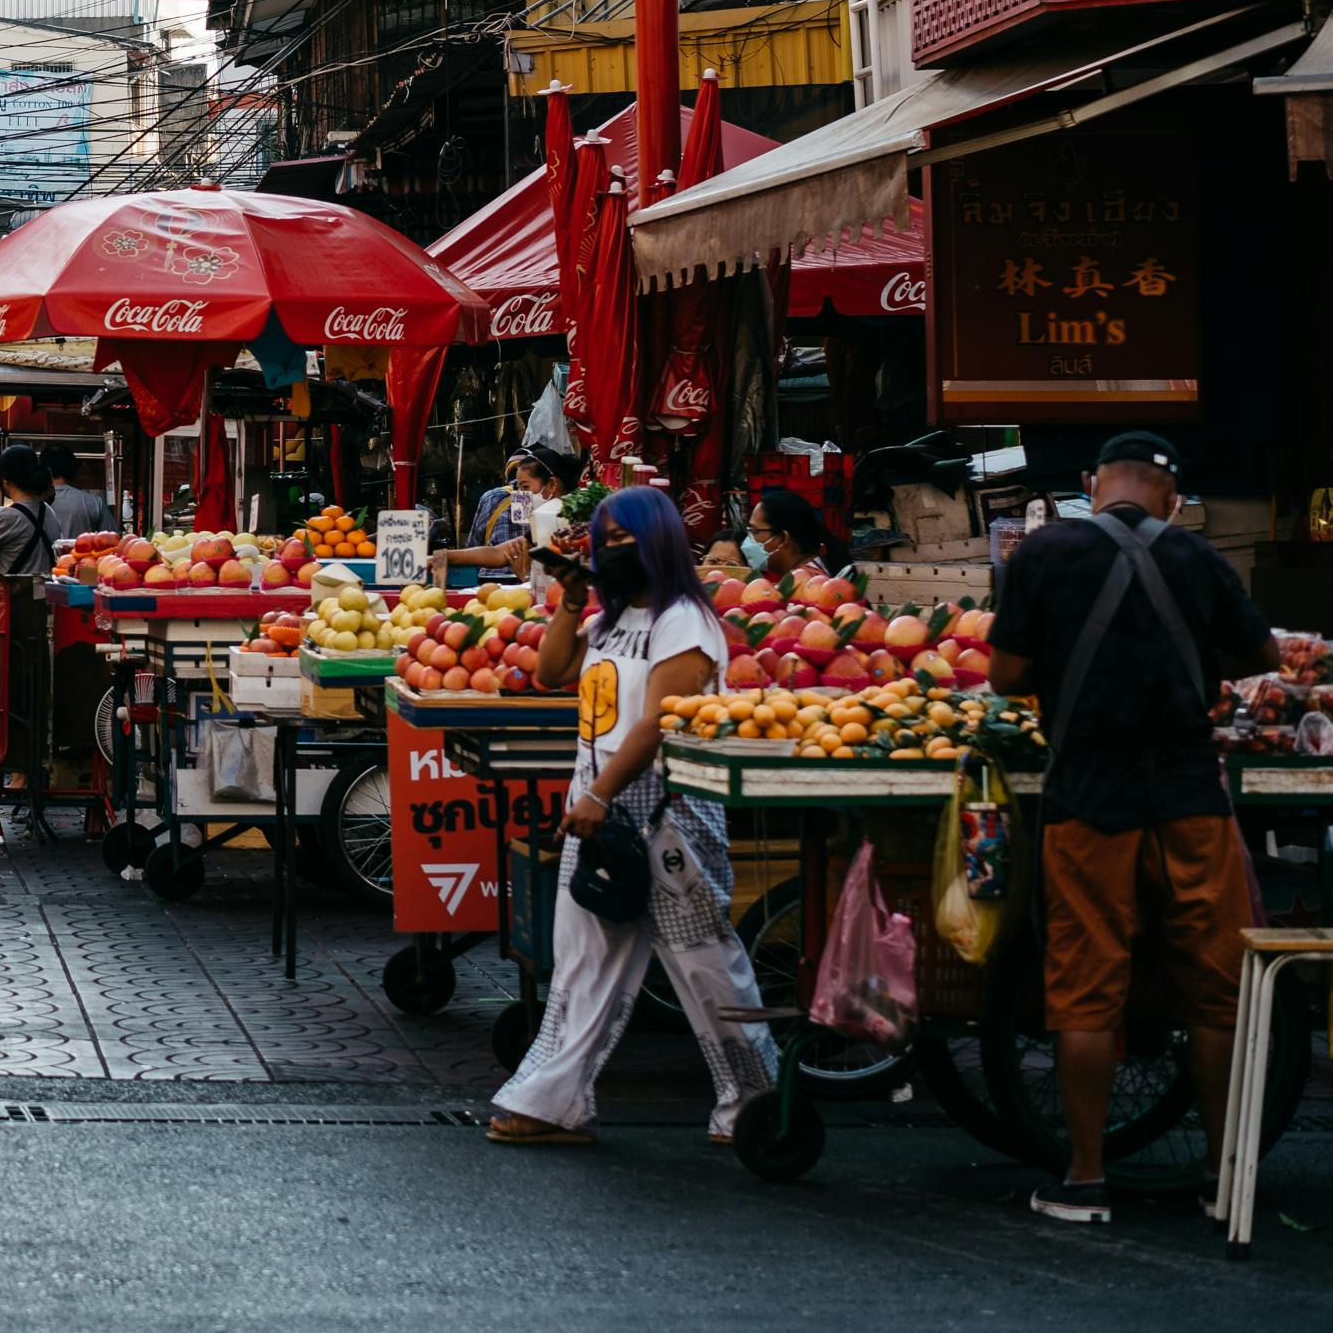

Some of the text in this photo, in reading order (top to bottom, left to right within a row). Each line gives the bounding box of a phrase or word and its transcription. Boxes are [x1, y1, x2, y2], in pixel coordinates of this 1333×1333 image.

[996, 254, 1177, 299] 林真香
[104, 298, 209, 333] Coca-Cola
[324, 306, 409, 341] Coca-Cola
[1015, 307, 1127, 346] Lim's
